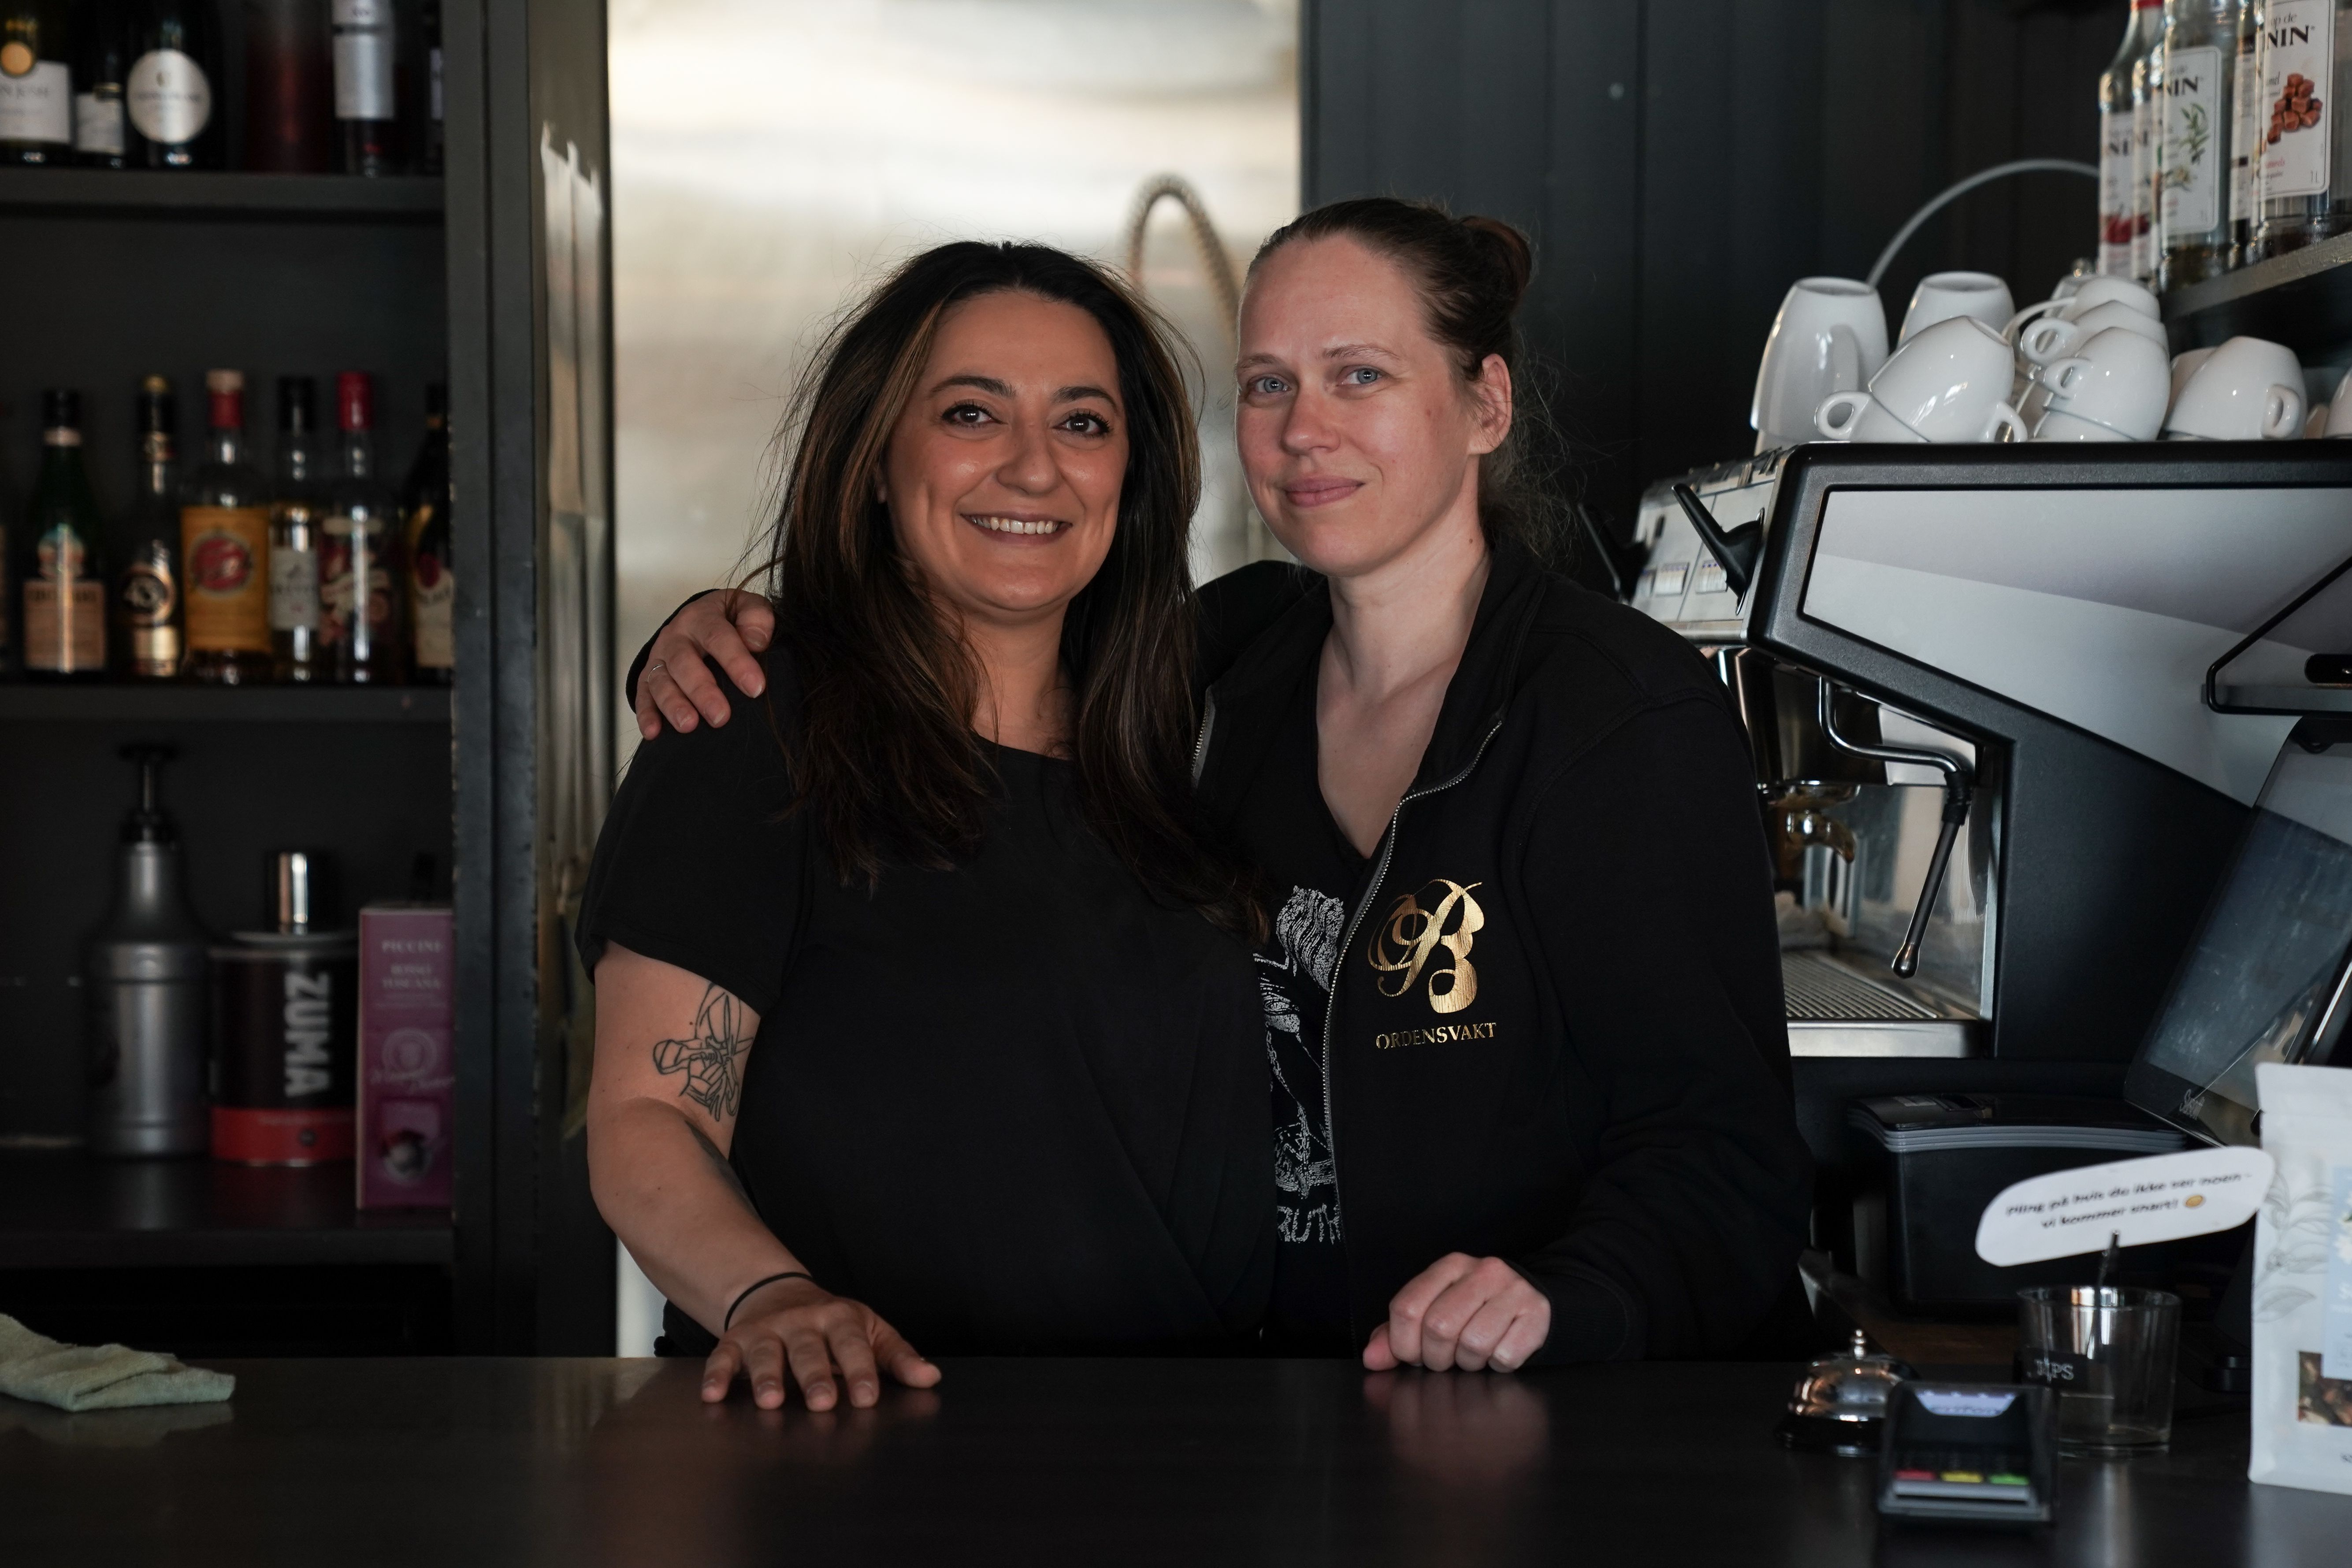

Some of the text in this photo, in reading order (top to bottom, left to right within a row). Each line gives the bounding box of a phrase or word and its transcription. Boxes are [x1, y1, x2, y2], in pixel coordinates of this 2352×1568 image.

[382, 939, 443, 954] PICCINI
[284, 971, 330, 1099] ZUMA
[1375, 1022, 1497, 1050] ORDENSVAKT
[2073, 1191, 2104, 1204] hvis
[2108, 1187, 2129, 1198] du
[2133, 1182, 2166, 1194] ikke
[2199, 1173, 2241, 1186] noen
[2060, 1206, 2125, 1226] kommer
